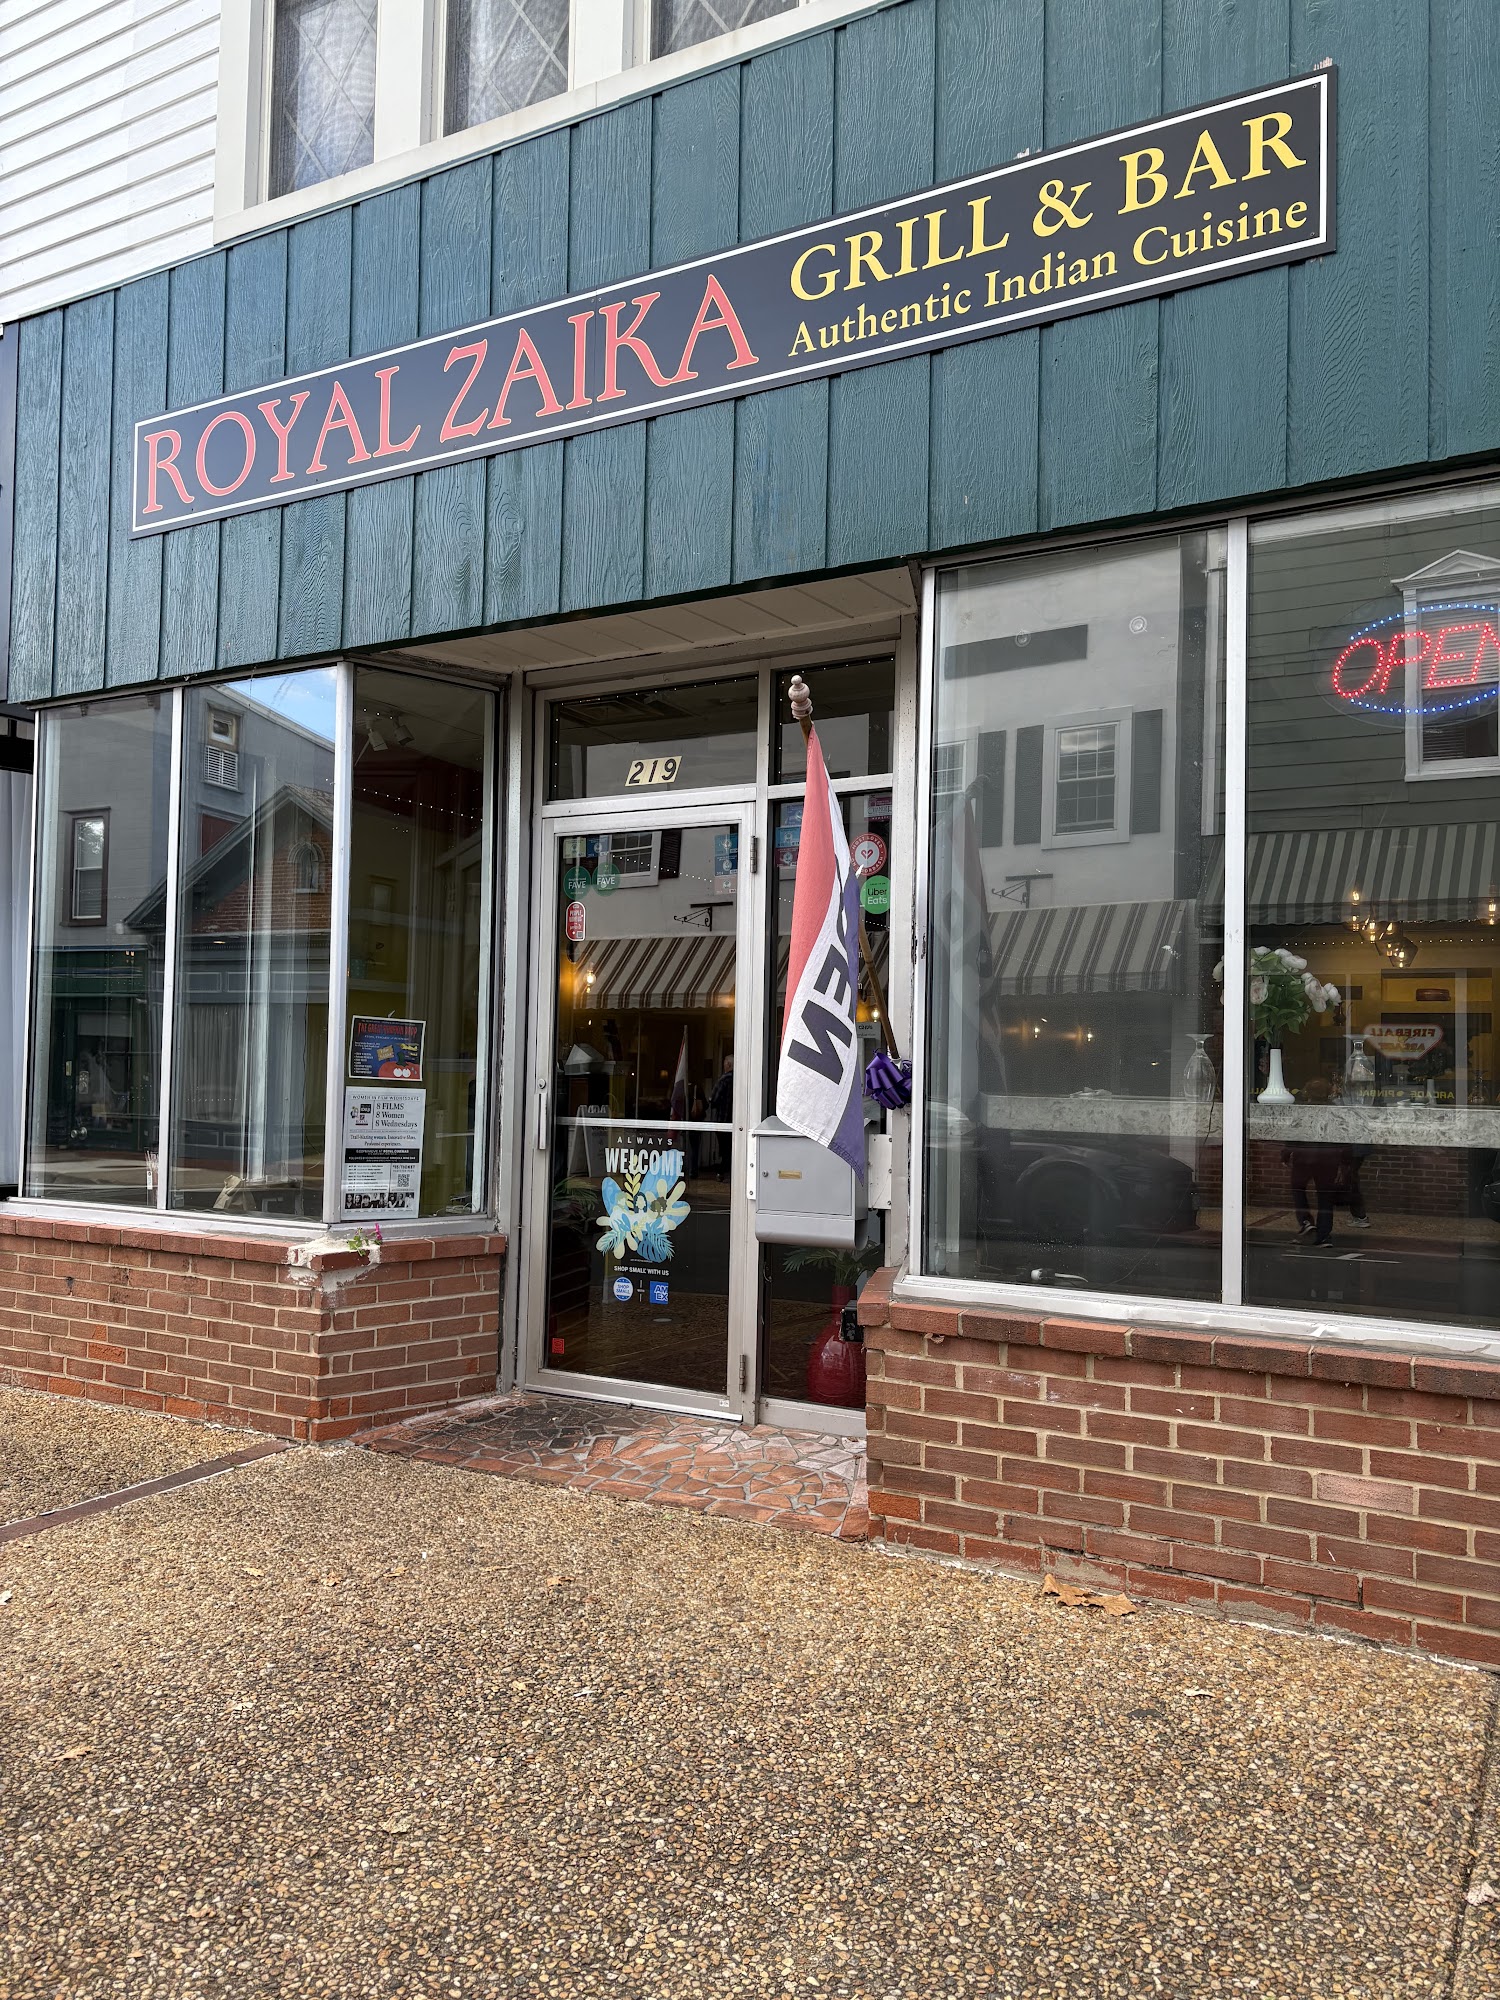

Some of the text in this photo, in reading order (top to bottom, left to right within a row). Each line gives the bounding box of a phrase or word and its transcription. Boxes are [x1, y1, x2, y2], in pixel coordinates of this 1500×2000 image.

[789, 110, 1308, 301] GRILL & BAR
[788, 200, 1309, 357] Authentic Indian Cuisine
[142, 273, 760, 515] ROYAL ZAIKA
[629, 758, 677, 784] 219
[852, 836, 883, 849] MOST LOVED
[856, 856, 883, 873] ORDASH
[568, 880, 586, 889] FAVE
[597, 876, 616, 886] FAVE
[867, 888, 888, 896] Uber
[867, 896, 888, 904] Eats
[381, 1120, 418, 1129] Wednesdays
[617, 1136, 673, 1145] ALWAYS
[604, 1147, 685, 1177] WELCOME
[654, 1285, 668, 1293] AM
[656, 1292, 668, 1301] EX
